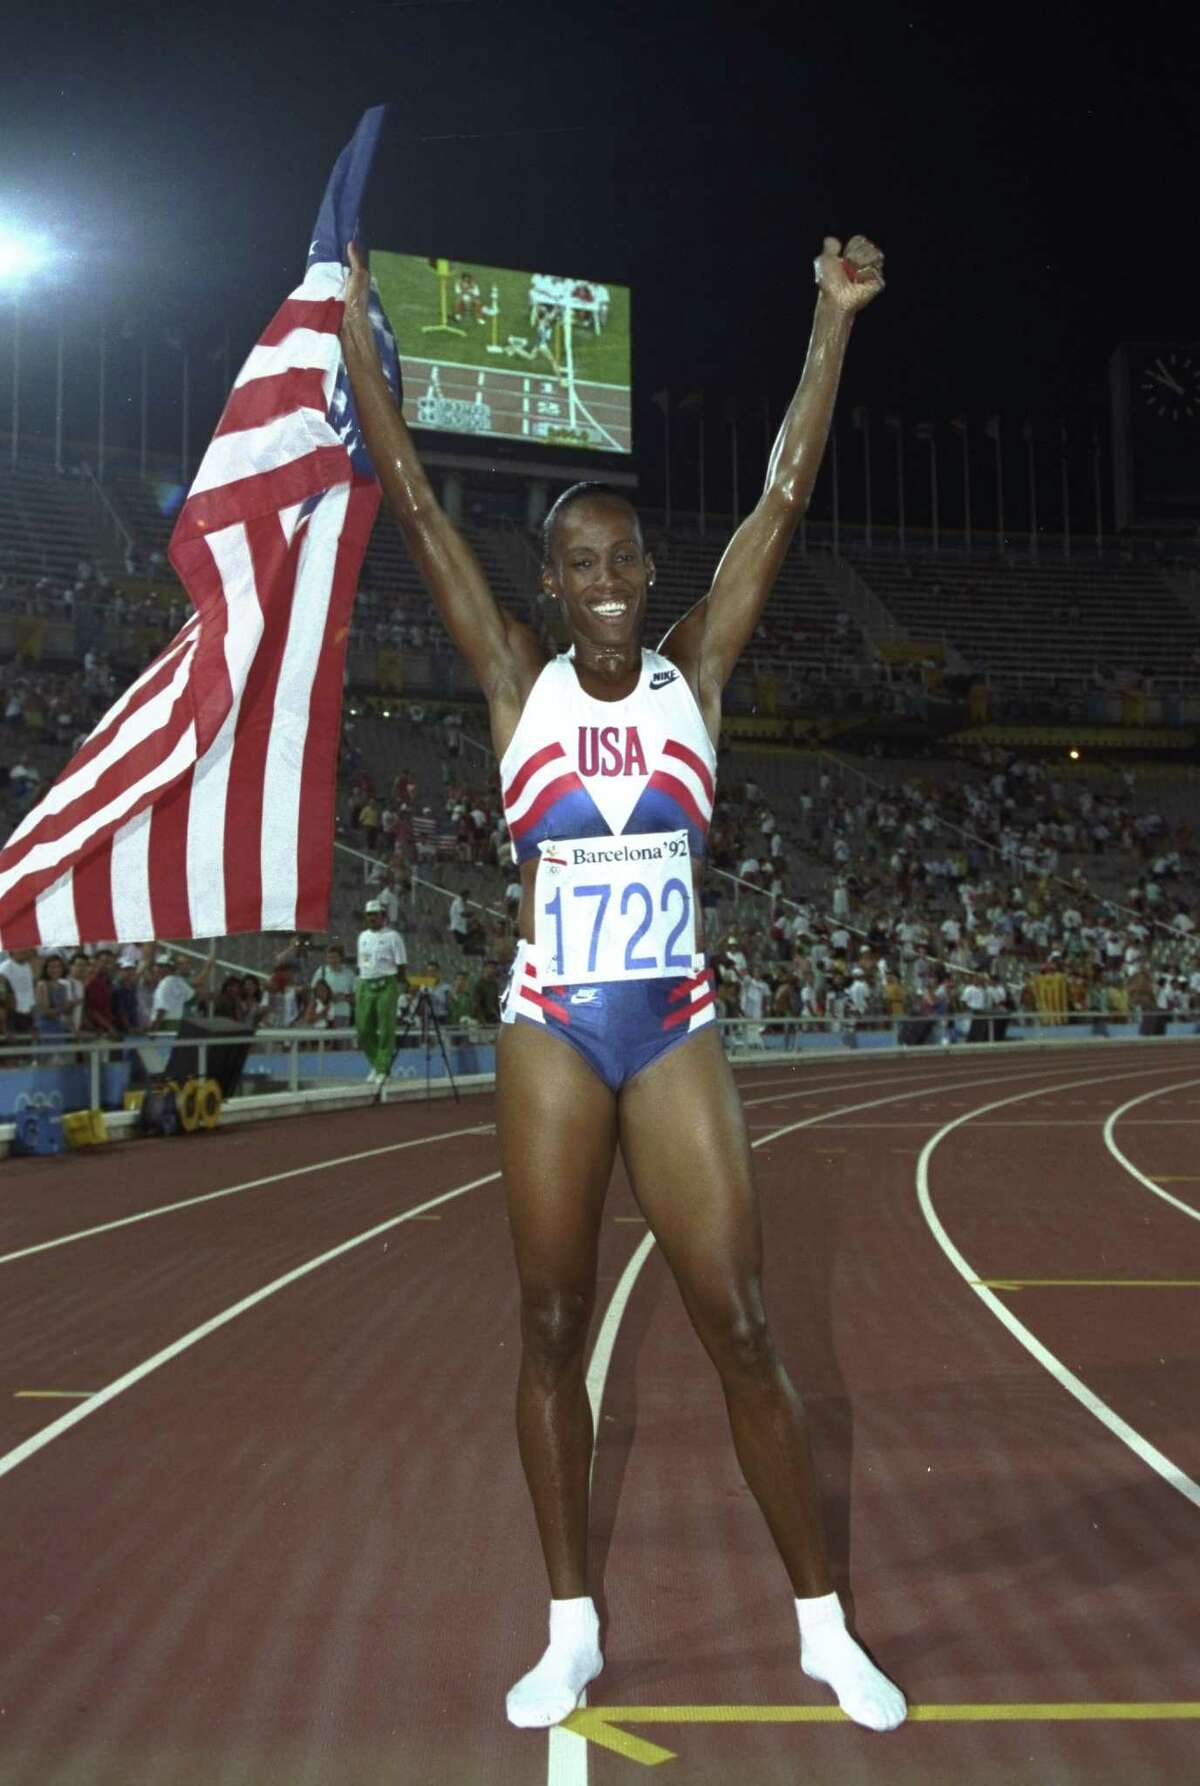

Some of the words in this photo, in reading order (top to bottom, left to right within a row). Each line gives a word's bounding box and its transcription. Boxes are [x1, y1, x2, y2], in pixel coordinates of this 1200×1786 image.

[653, 669, 677, 681] NIKE
[578, 726, 649, 777] USA
[544, 877, 693, 976] 1722
